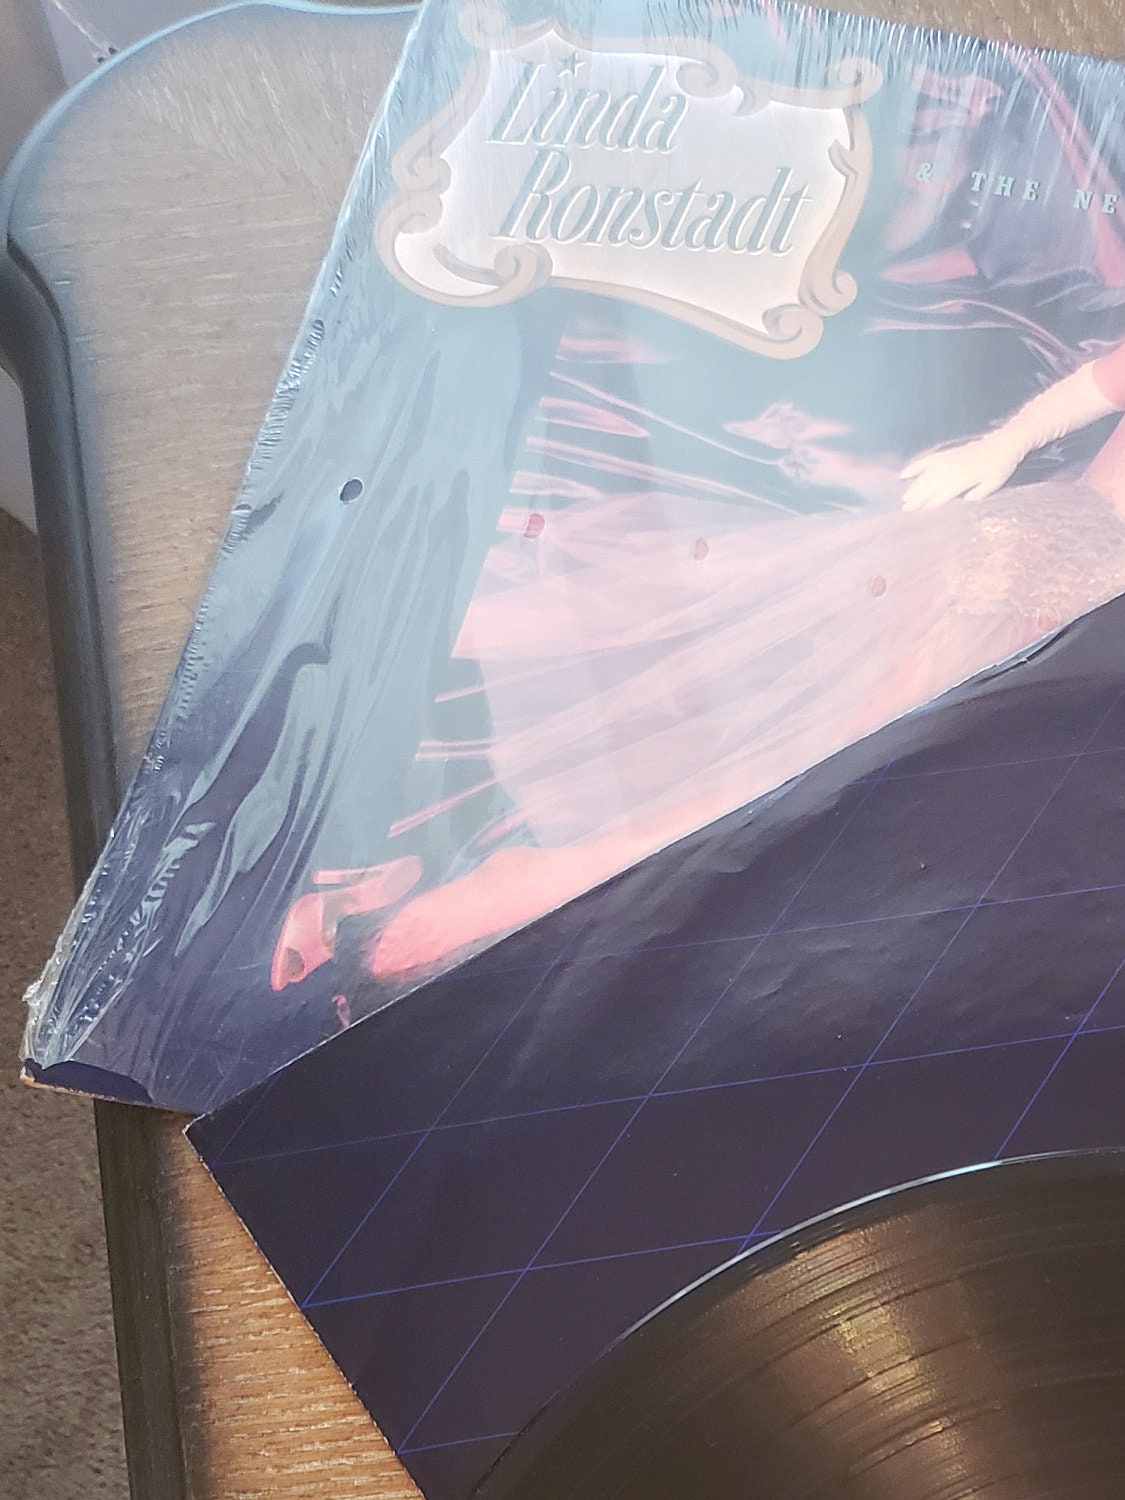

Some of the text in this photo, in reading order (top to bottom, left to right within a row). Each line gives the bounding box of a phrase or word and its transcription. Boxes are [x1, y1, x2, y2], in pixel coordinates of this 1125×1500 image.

[484, 52, 688, 154] Linda
[487, 149, 815, 257] Ronstadt
[916, 162, 933, 183] &
[970, 171, 1041, 201] THE
